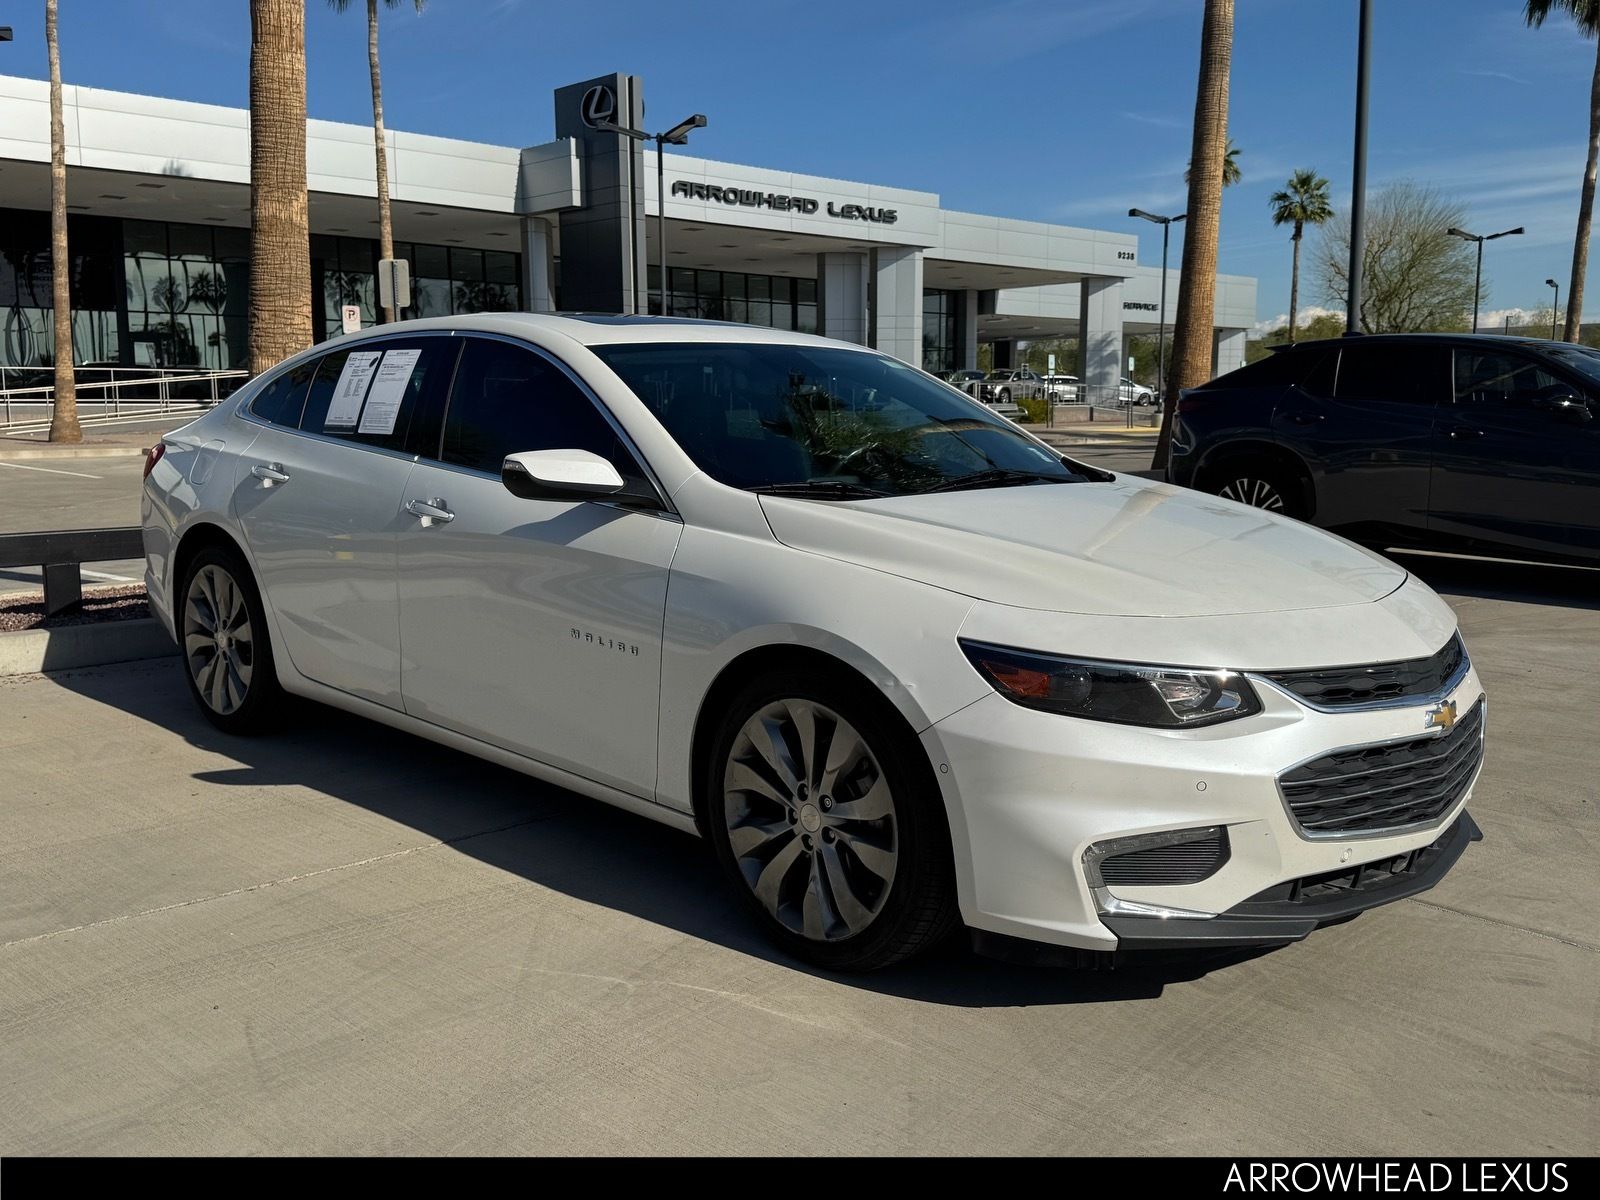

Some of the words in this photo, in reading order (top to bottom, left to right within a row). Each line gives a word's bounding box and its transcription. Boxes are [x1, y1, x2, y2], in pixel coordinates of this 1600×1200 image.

[672, 180, 819, 214] ARROWHEAD
[828, 201, 898, 224] LEXUS
[1122, 301, 1159, 311] SERVICE
[570, 628, 639, 656] MALIBU
